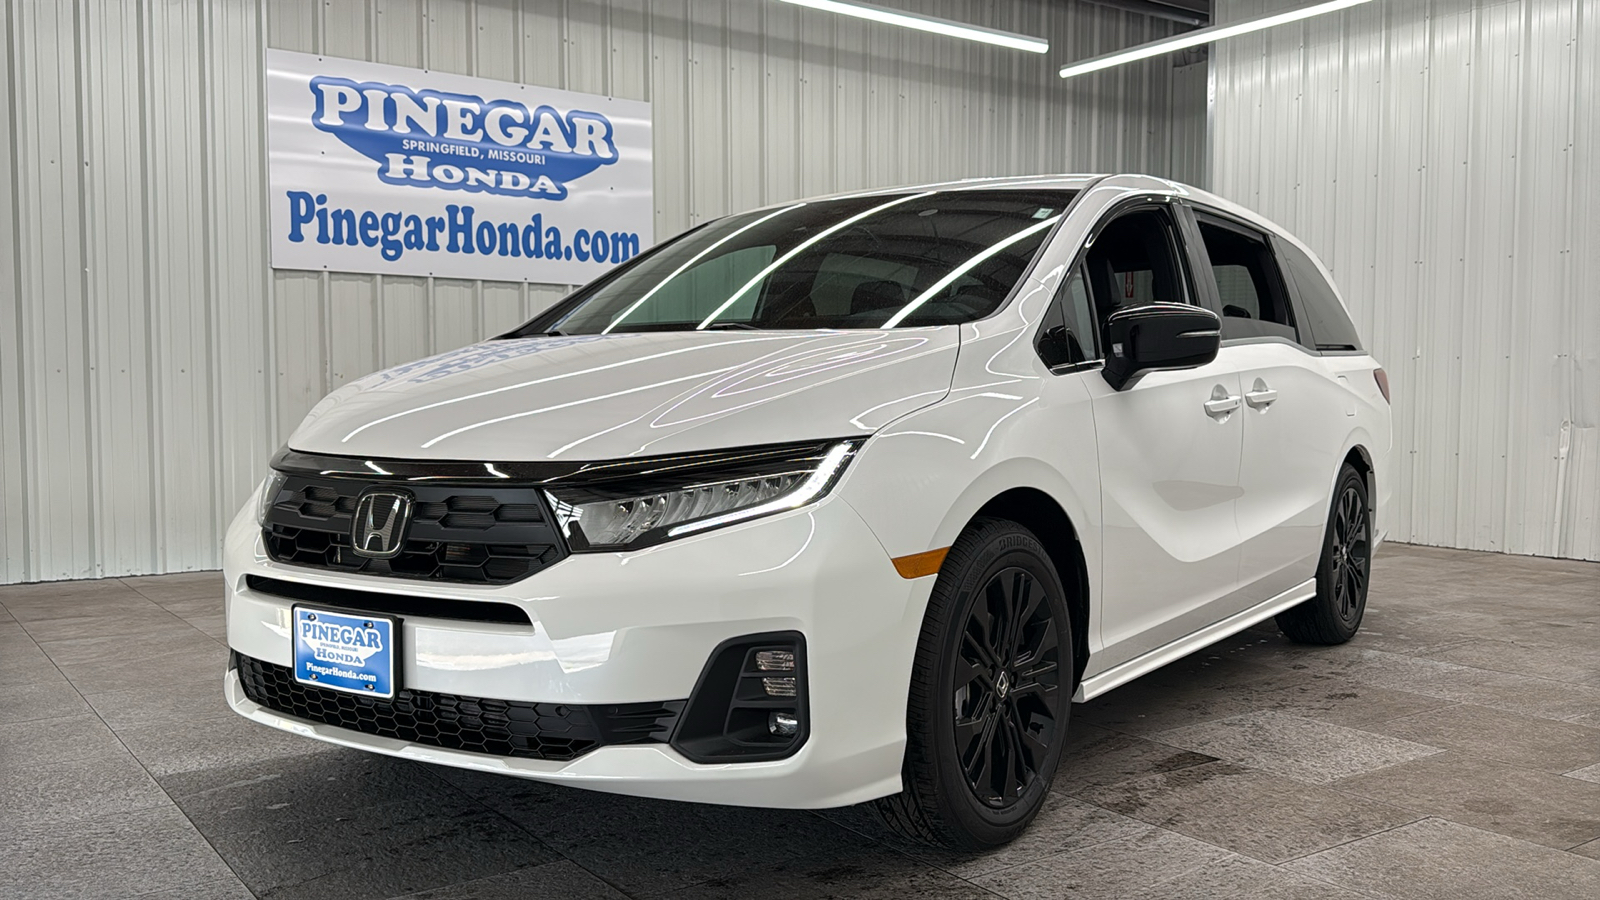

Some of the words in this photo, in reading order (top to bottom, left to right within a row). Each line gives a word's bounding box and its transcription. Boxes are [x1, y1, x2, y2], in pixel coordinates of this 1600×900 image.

[316, 83, 614, 159] PINEGAR
[402, 139, 485, 160] SPRINGFIELD,
[488, 149, 545, 165] MISSOURI
[384, 153, 562, 195] HONDA
[286, 190, 640, 264] PinegarHonda.com
[302, 622, 380, 649] PINEGAR
[316, 647, 364, 665] HONDA
[306, 661, 377, 682] PinegarHonda.com
